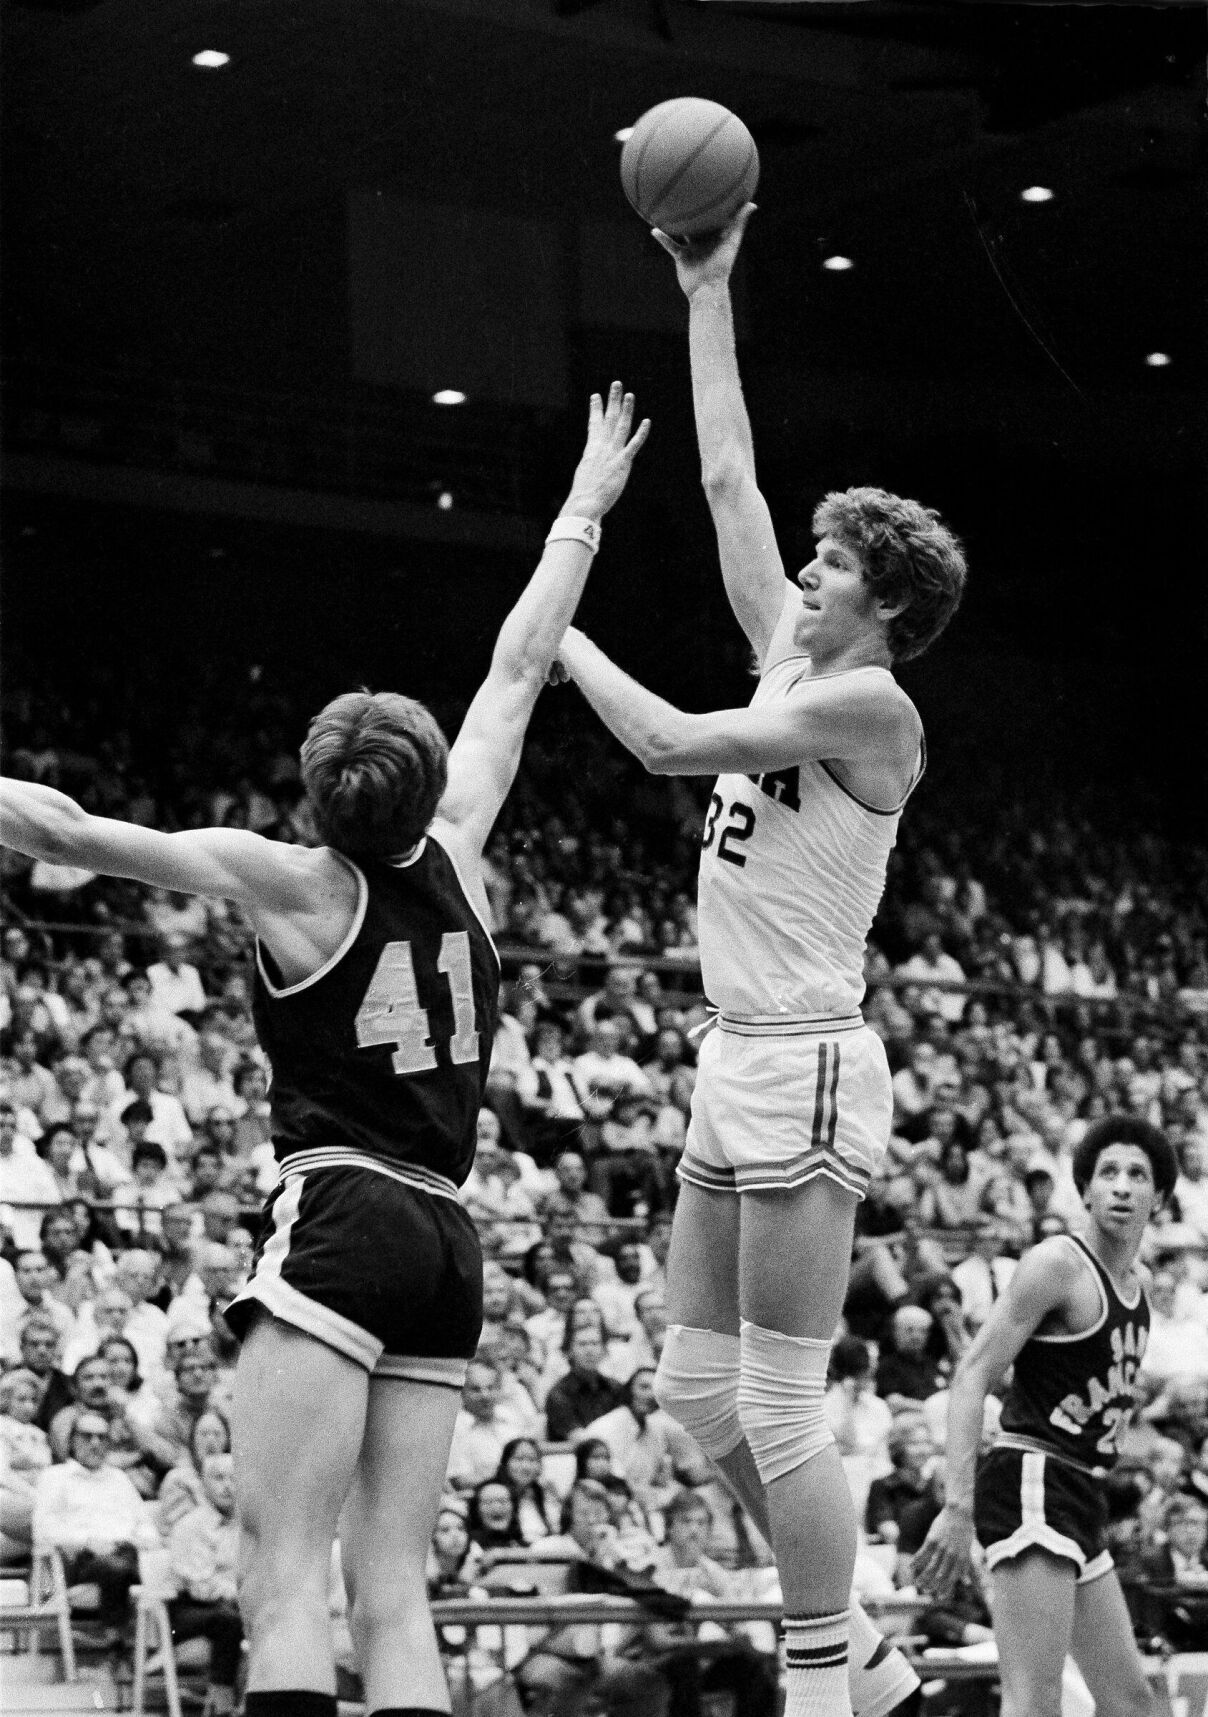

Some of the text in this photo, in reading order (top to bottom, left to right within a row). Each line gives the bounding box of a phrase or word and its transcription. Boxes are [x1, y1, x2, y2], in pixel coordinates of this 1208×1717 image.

[583, 525, 595, 540] 4
[701, 791, 756, 868] 32
[354, 930, 481, 1075] 41
